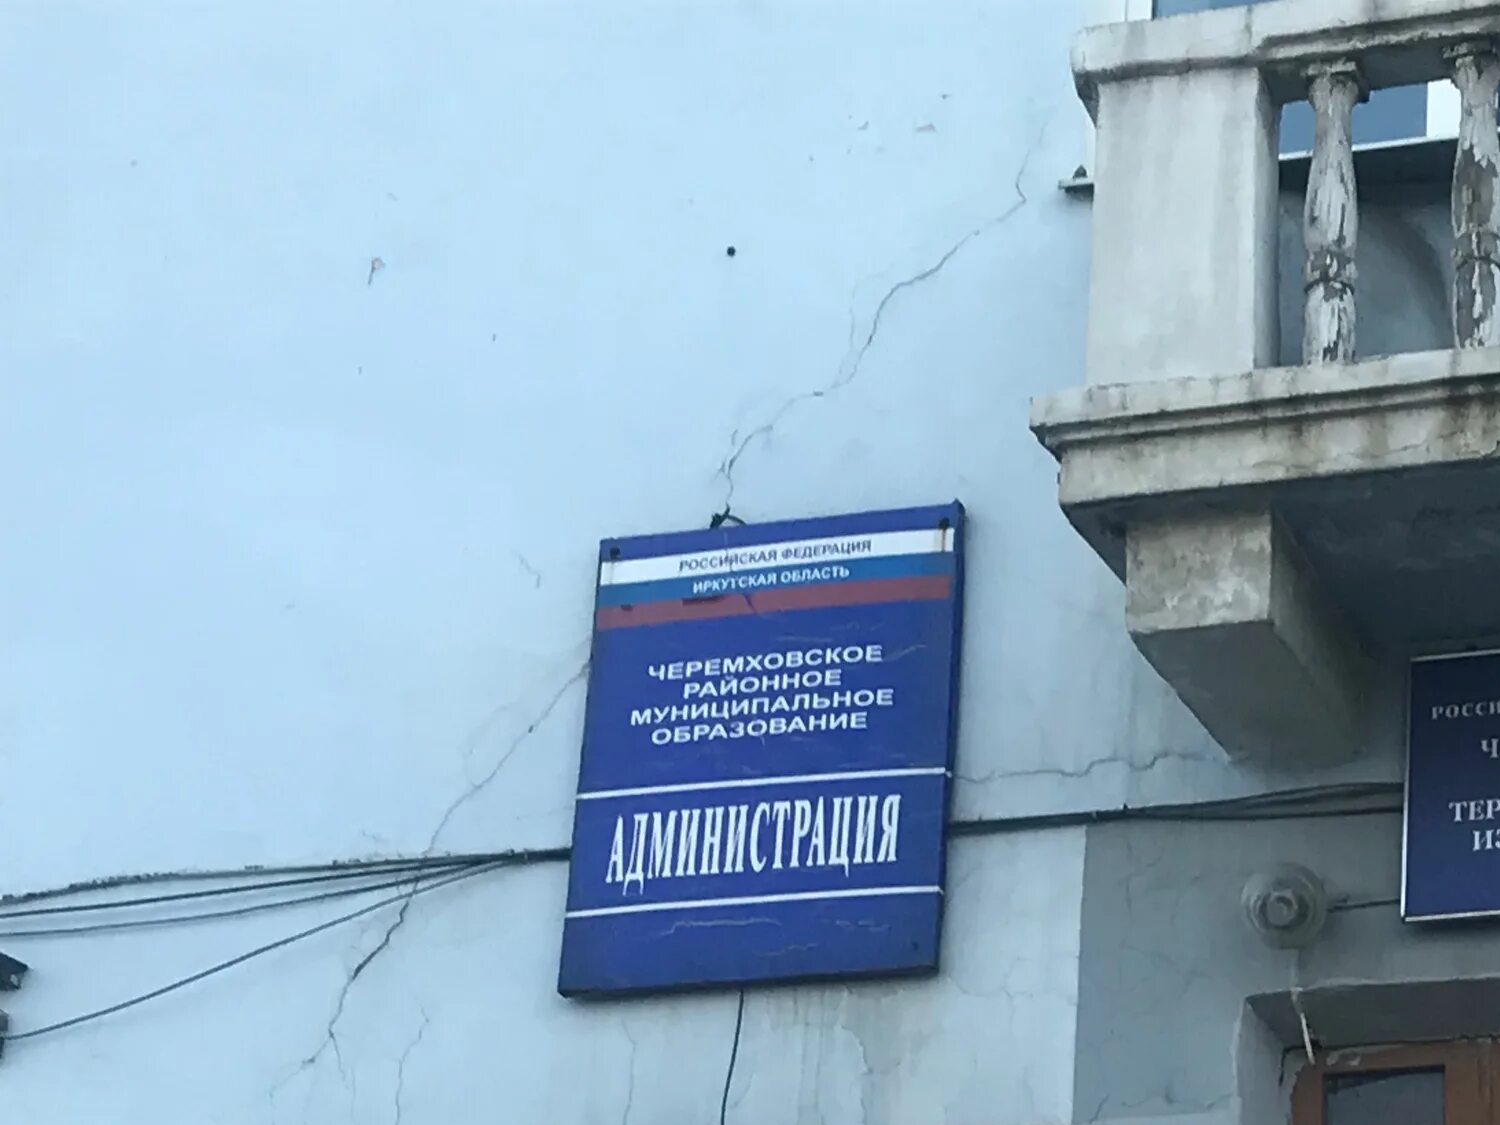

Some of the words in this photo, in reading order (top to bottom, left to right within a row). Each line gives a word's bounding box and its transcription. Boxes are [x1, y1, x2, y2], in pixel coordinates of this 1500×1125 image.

[679, 547, 778, 572] РОССИЙСКАЯ
[781, 539, 872, 564] ФЕДЕРАЦИЯ
[692, 572, 777, 595] ИРКУТСКАЯ
[780, 565, 850, 585] ОБЛАСТЬ
[648, 645, 883, 680] ЧЕРЕМХОВСКОЕ
[683, 669, 842, 699] РАЙОННОЕ
[630, 689, 894, 726] МУНИЦИПАЛЬНОЕ
[651, 712, 868, 745] ОБРАЗОВАНИЕ
[605, 794, 902, 896] АДМИНИСТРАЦИЯ
